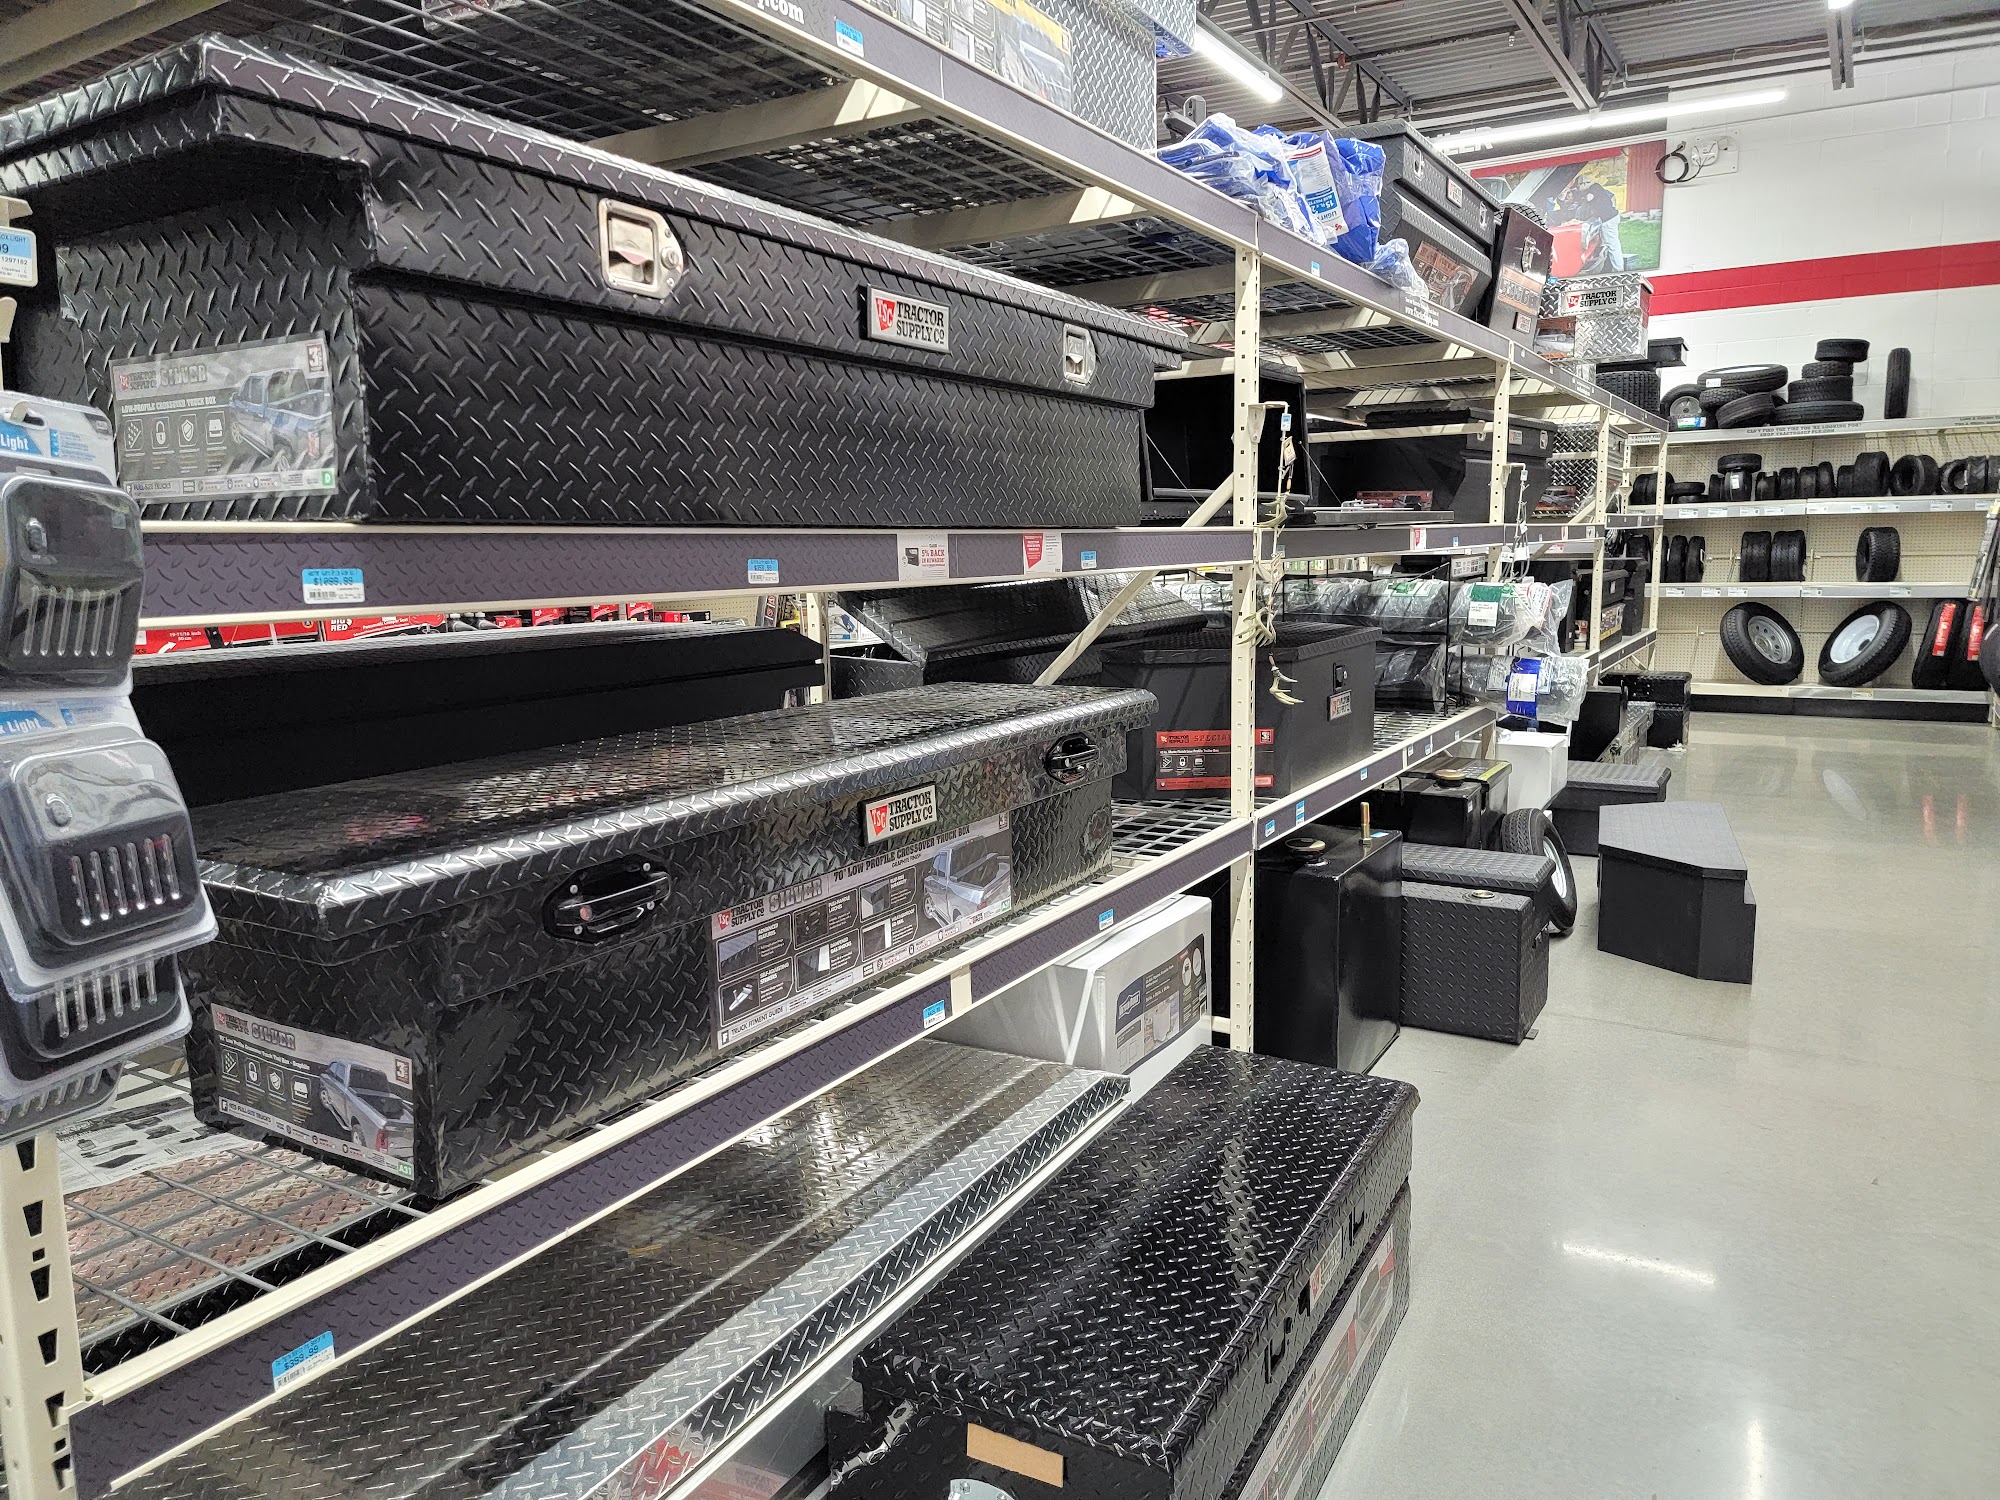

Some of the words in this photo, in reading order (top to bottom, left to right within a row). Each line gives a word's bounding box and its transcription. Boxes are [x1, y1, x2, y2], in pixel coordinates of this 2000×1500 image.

[1580, 298, 1607, 308] SUPPLY
[1581, 290, 1617, 300] TRACTOR
[876, 299, 893, 328] TSC
[896, 300, 945, 328] TRACTOR
[896, 319, 933, 342] SUPPLY
[0, 432, 30, 452] Light
[930, 549, 945, 557] BACK
[330, 624, 348, 632] RED
[7, 717, 43, 734] Light
[1194, 734, 1231, 743] SPECIA
[871, 806, 886, 829] TSC
[888, 790, 932, 816] TRACTOR
[889, 808, 922, 832] SUPPLY
[730, 898, 764, 917] TRACTOR
[768, 879, 823, 913] SILVER
[847, 862, 864, 877] LOW
[865, 851, 896, 873] PROFILE
[896, 840, 935, 860] CROSSOVER
[936, 831, 958, 847] TRUCK
[958, 827, 970, 839] BOX
[731, 911, 756, 928] SUPPLY
[731, 1024, 748, 1036] TRUCK
[748, 1013, 768, 1030] FITMENT
[768, 1005, 784, 1019] GUIDE
[251, 1022, 296, 1051] SILVER
